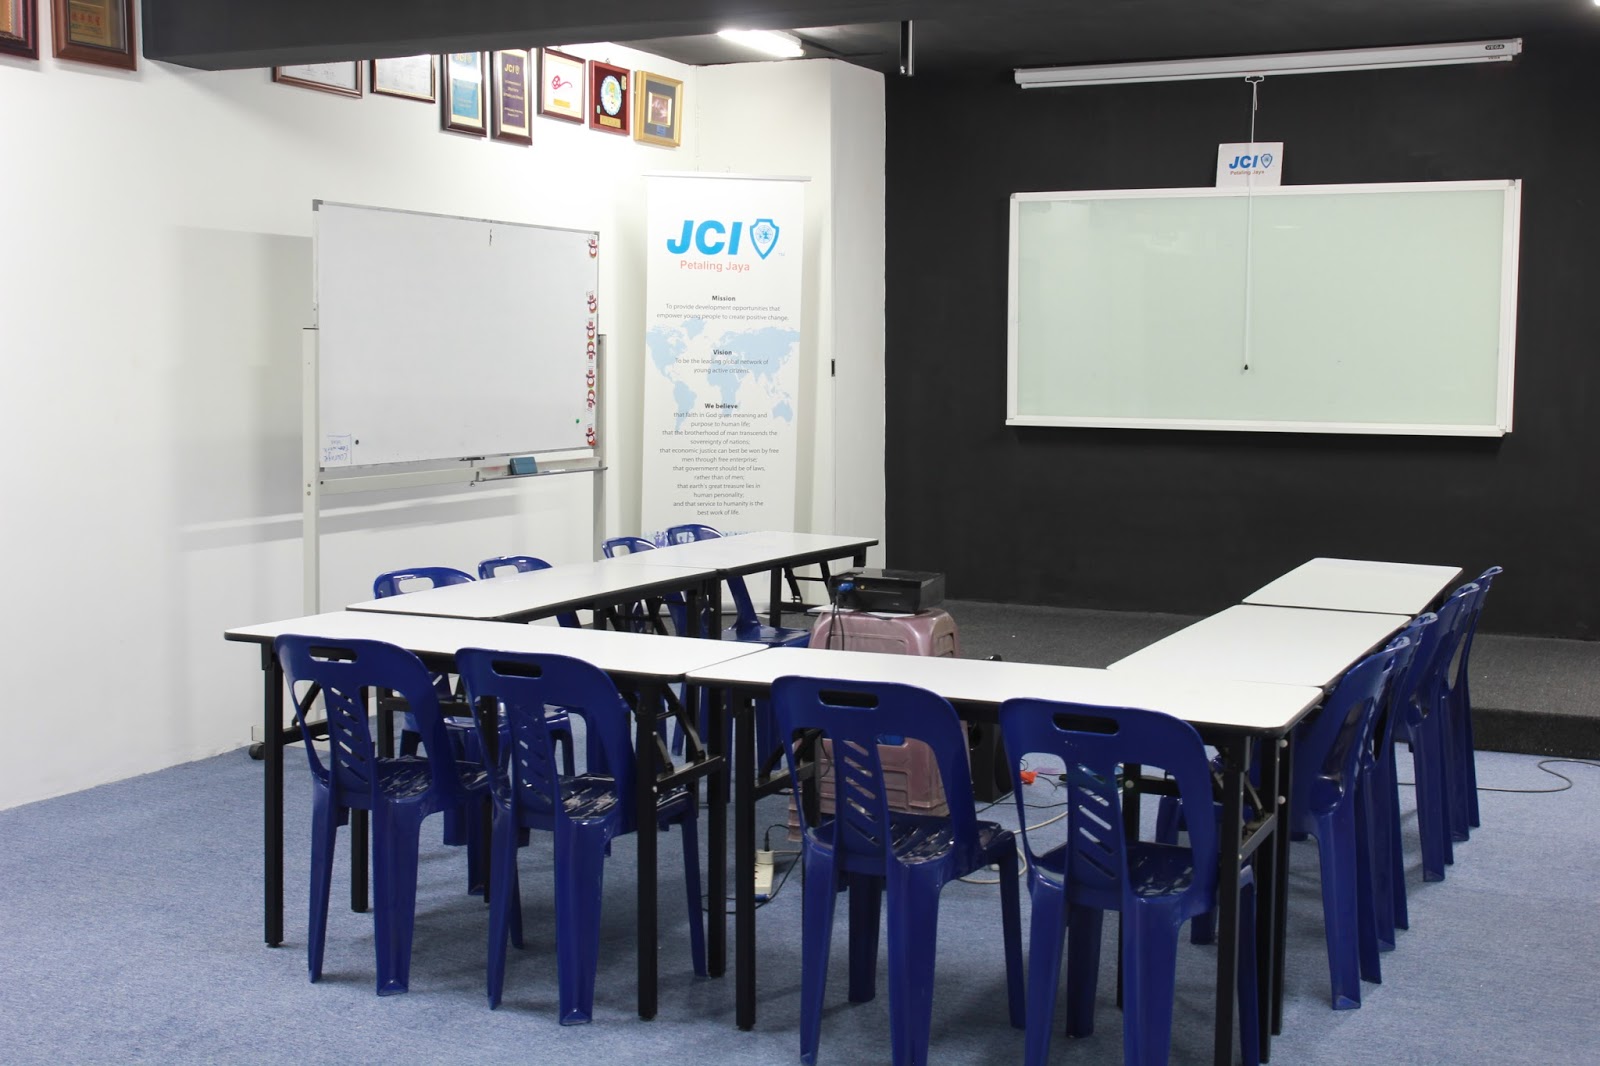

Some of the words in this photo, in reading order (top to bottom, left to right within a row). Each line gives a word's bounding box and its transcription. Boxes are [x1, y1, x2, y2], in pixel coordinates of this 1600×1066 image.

[505, 64, 514, 73] JCI
[1229, 155, 1258, 169] JCI
[666, 220, 743, 255] JCI
[680, 260, 722, 272] Petaling
[726, 262, 750, 272] Jaya
